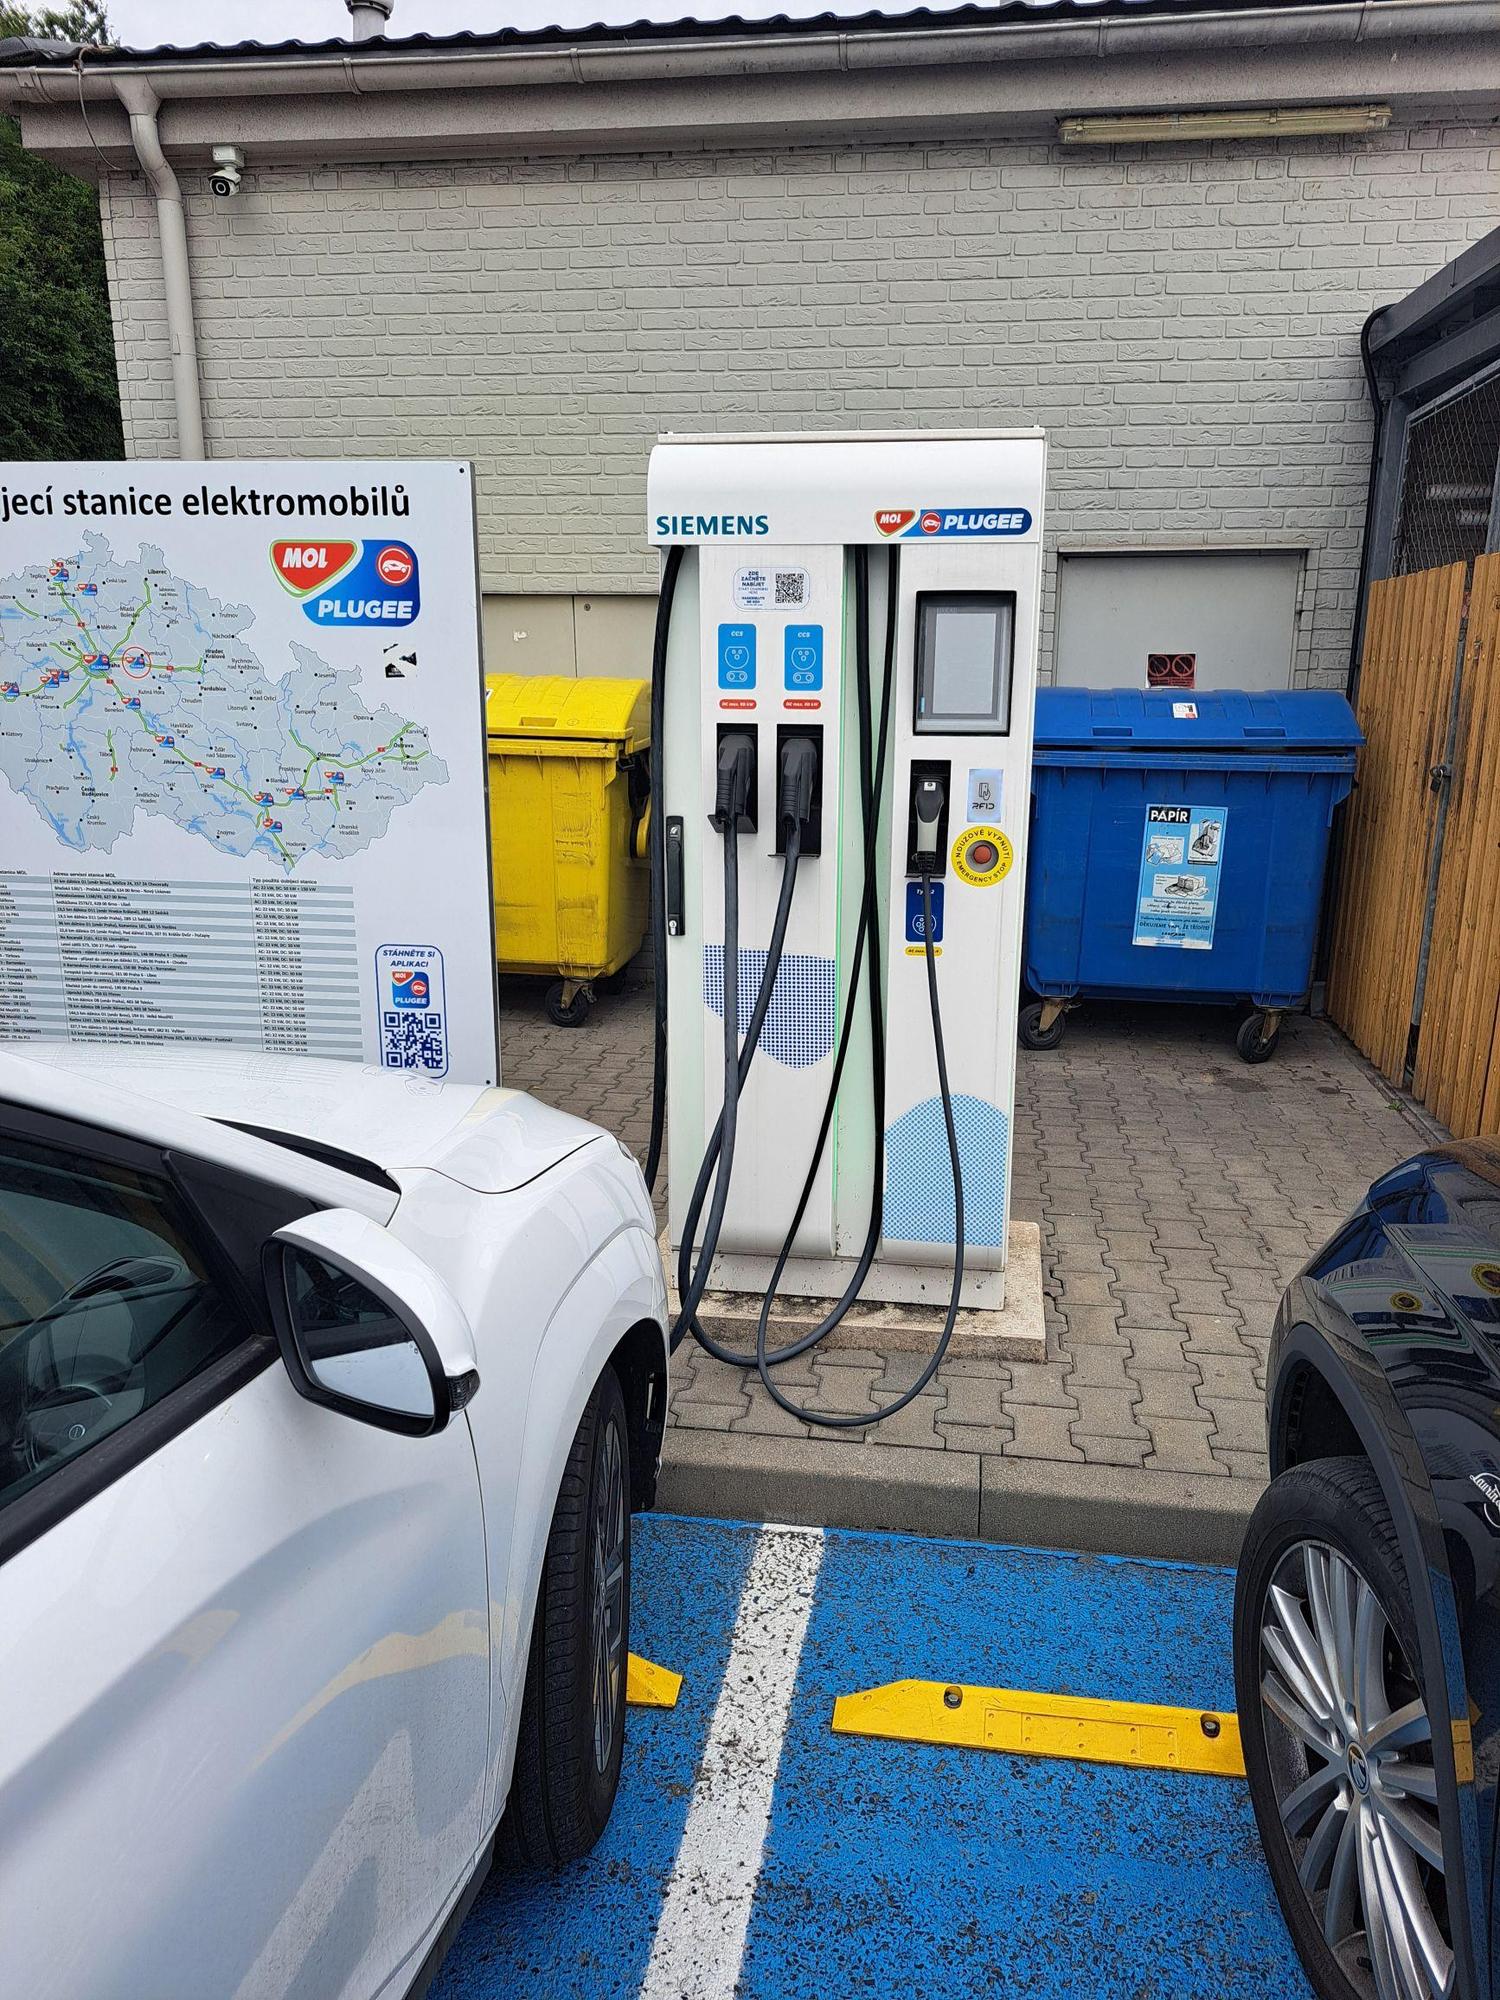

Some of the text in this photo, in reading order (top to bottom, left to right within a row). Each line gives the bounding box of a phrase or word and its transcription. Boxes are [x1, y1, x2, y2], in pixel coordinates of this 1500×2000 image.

[2, 485, 410, 521] jecí stanice elektromobilů
[656, 515, 769, 536] SIEMENS
[879, 513, 1023, 530] MOL PLUGEE
[282, 548, 328, 569] MOL
[317, 600, 412, 620] PLUGEE
[1150, 808, 1188, 822] PAPÍR
[956, 828, 1010, 862] NOUZOVÉ VYPNUTÍ
[956, 860, 1008, 883] EMERGENCY STOP
[383, 949, 425, 957] STÁHNĚTE
